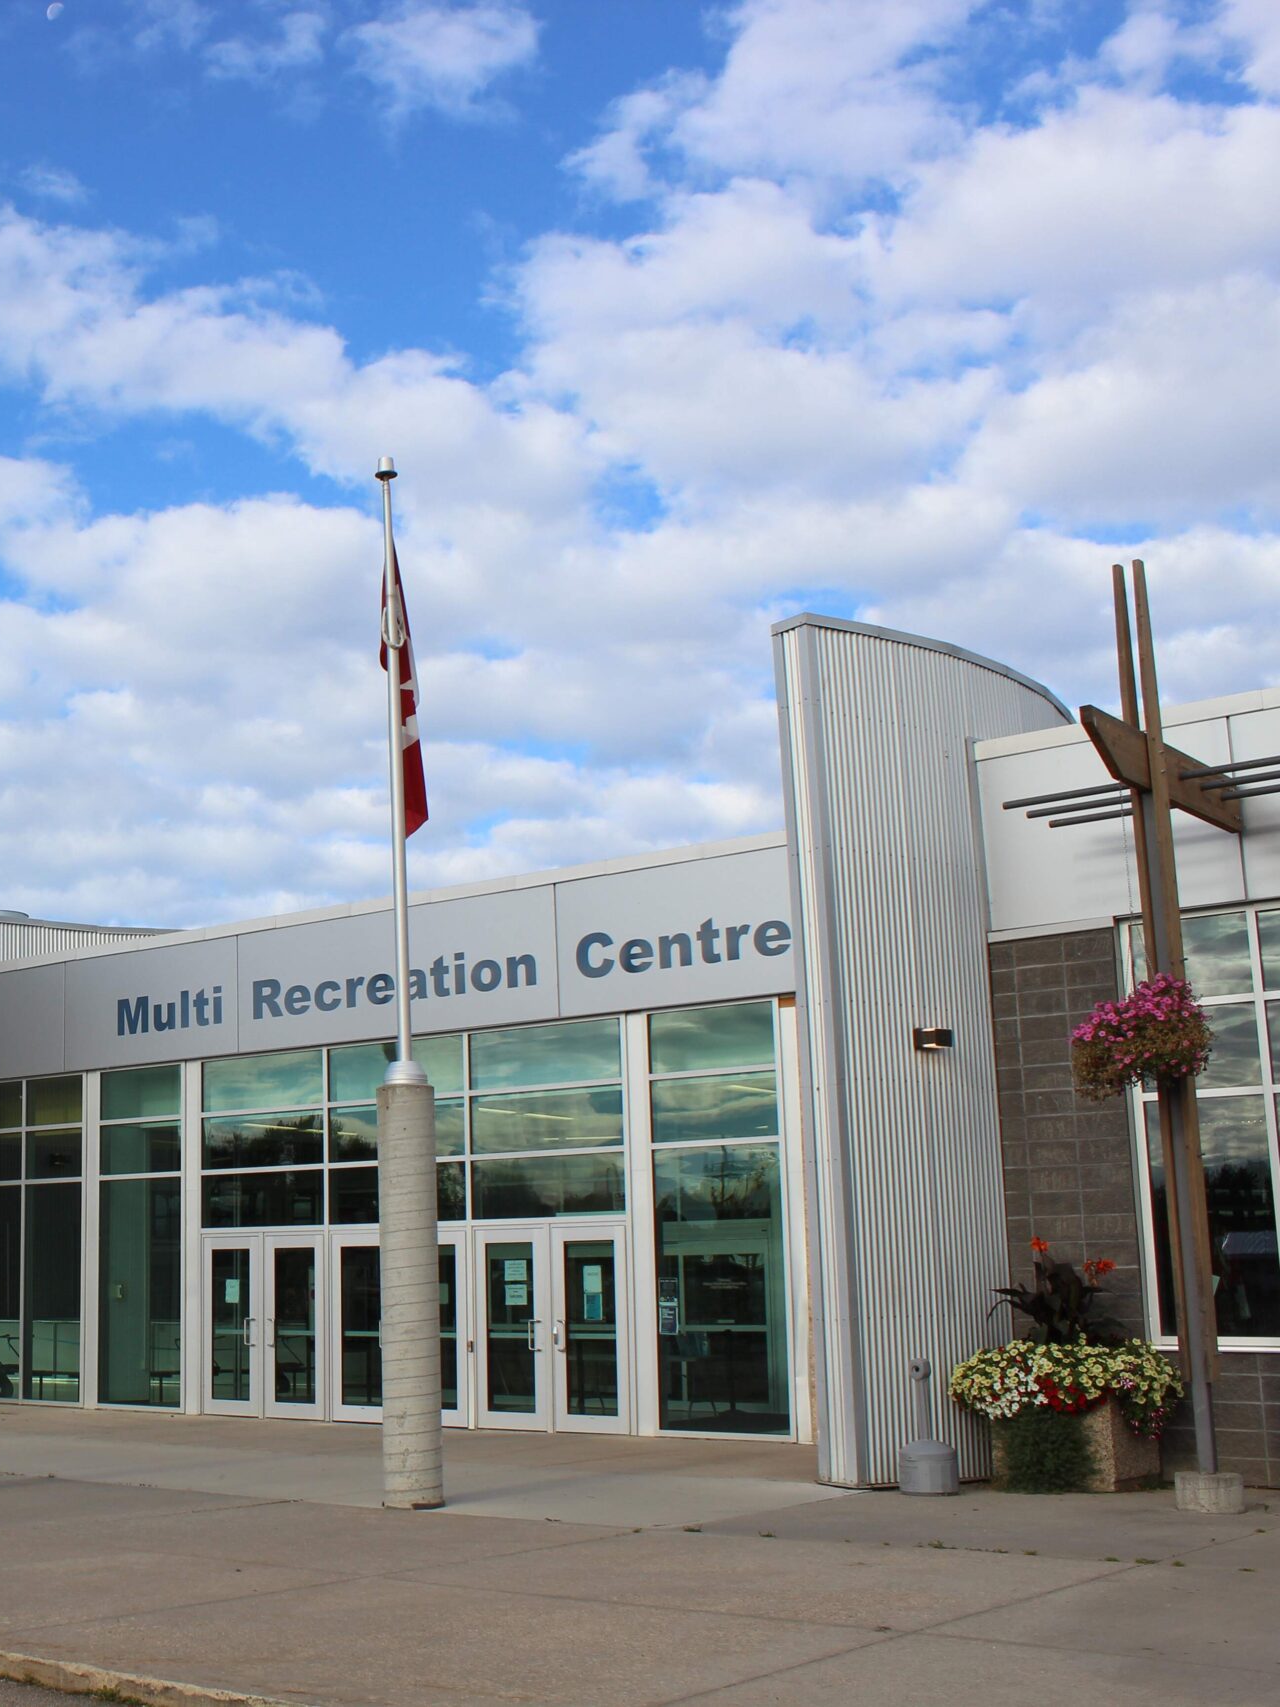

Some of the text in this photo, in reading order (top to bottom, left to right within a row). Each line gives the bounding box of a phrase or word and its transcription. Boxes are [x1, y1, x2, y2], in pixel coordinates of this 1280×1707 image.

[117, 917, 792, 1036] Multi Recreation Centre
